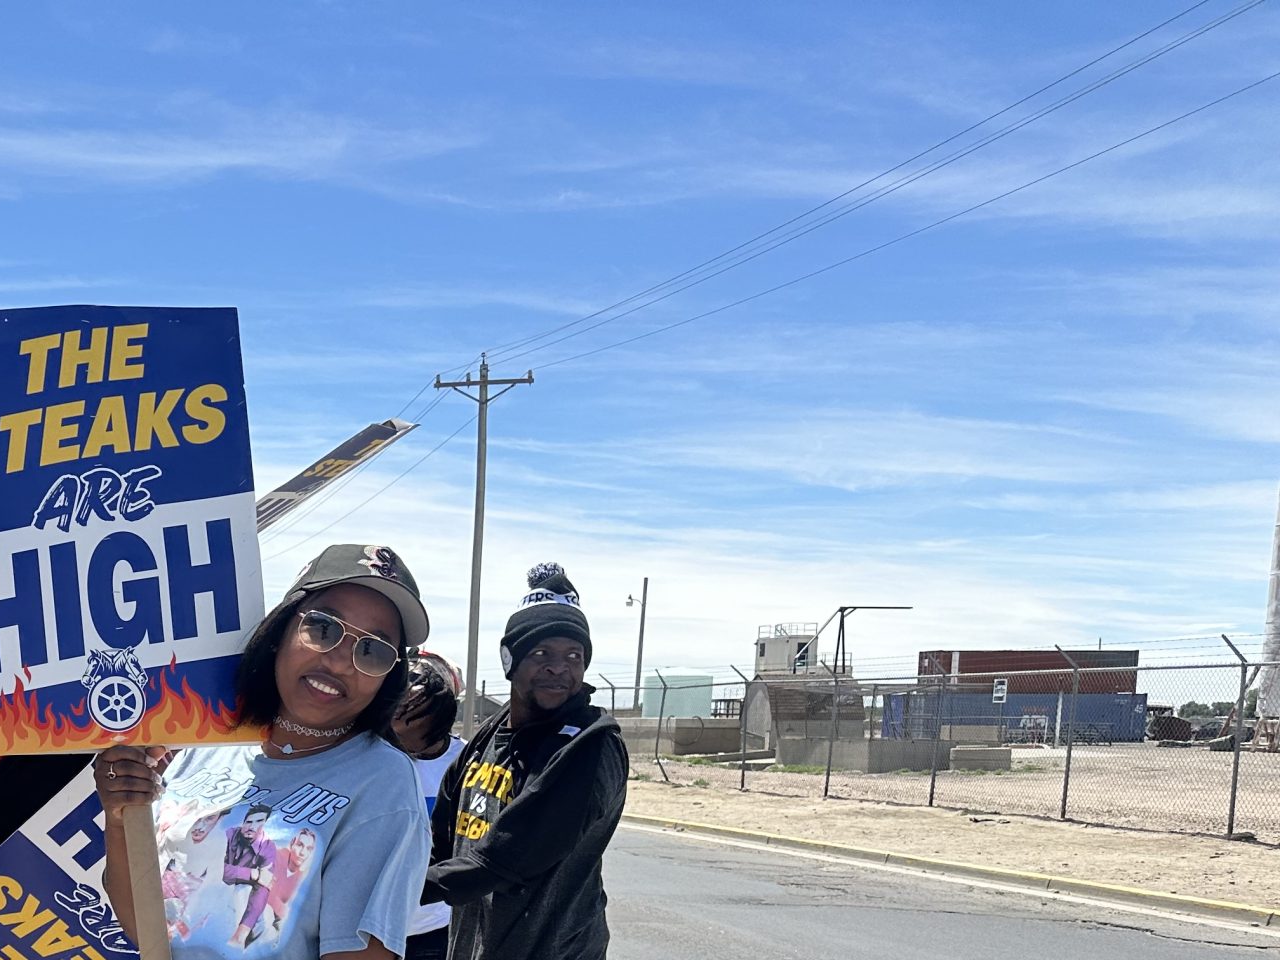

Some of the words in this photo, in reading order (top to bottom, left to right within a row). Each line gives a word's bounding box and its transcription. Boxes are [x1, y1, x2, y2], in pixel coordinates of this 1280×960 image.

[20, 323, 148, 394] THE
[31, 464, 162, 532] ARE
[469, 793, 487, 813] VS
